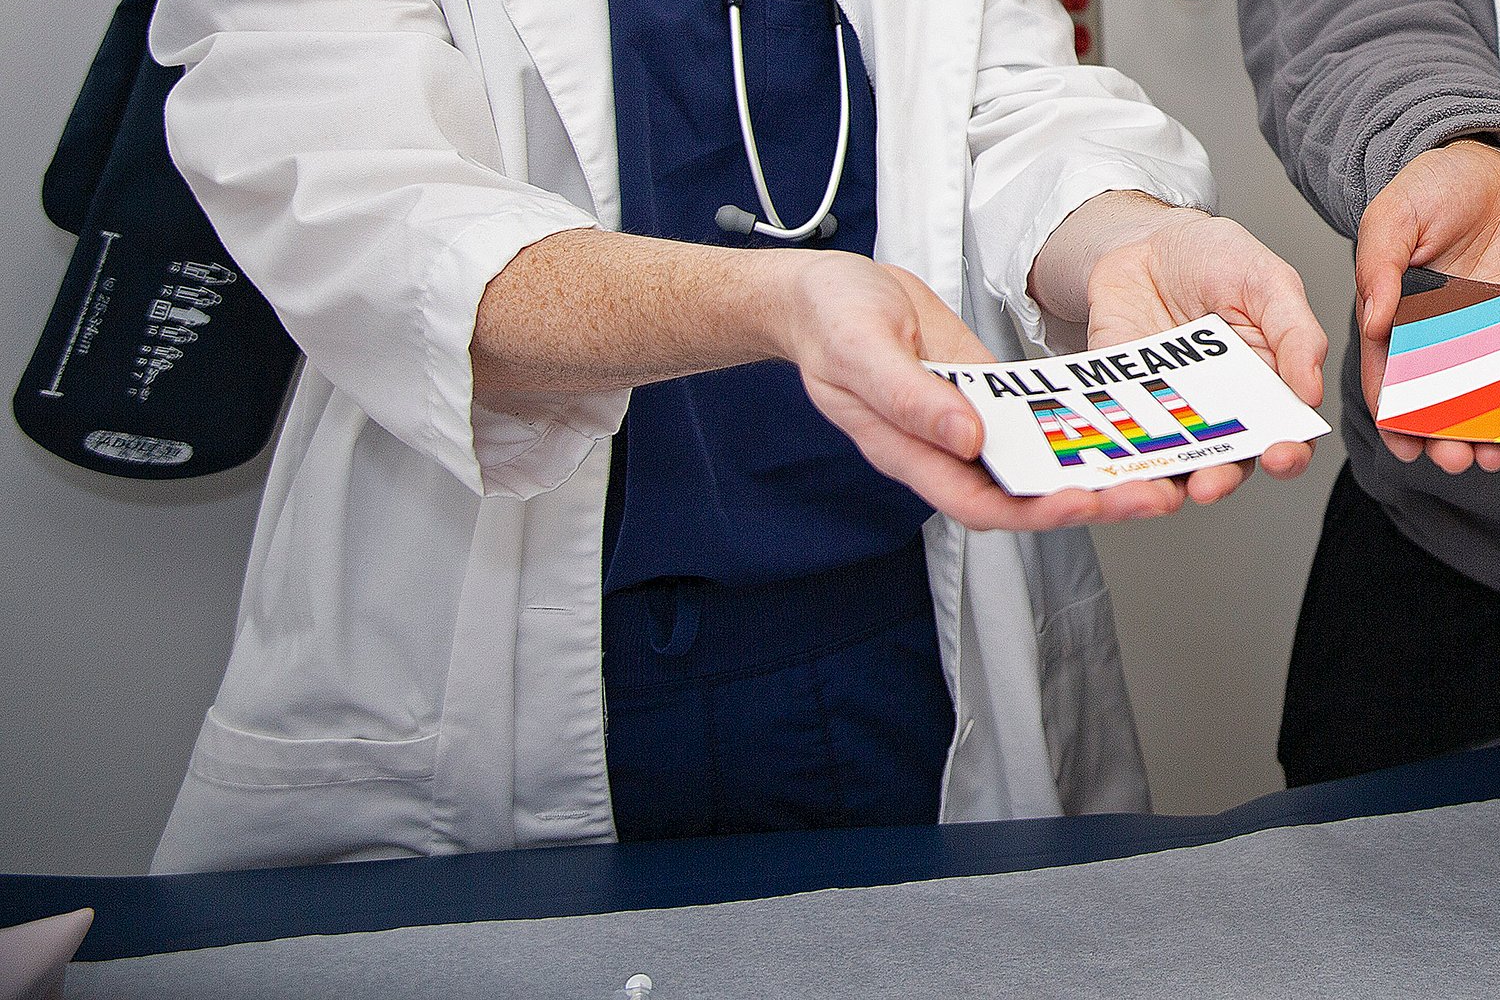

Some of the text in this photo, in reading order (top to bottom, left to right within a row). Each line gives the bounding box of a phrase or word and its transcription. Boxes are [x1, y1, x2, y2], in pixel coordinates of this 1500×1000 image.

[1065, 328, 1229, 388] MEANS
[1027, 377, 1248, 467] ALL
[1177, 442, 1234, 462] CENTER
